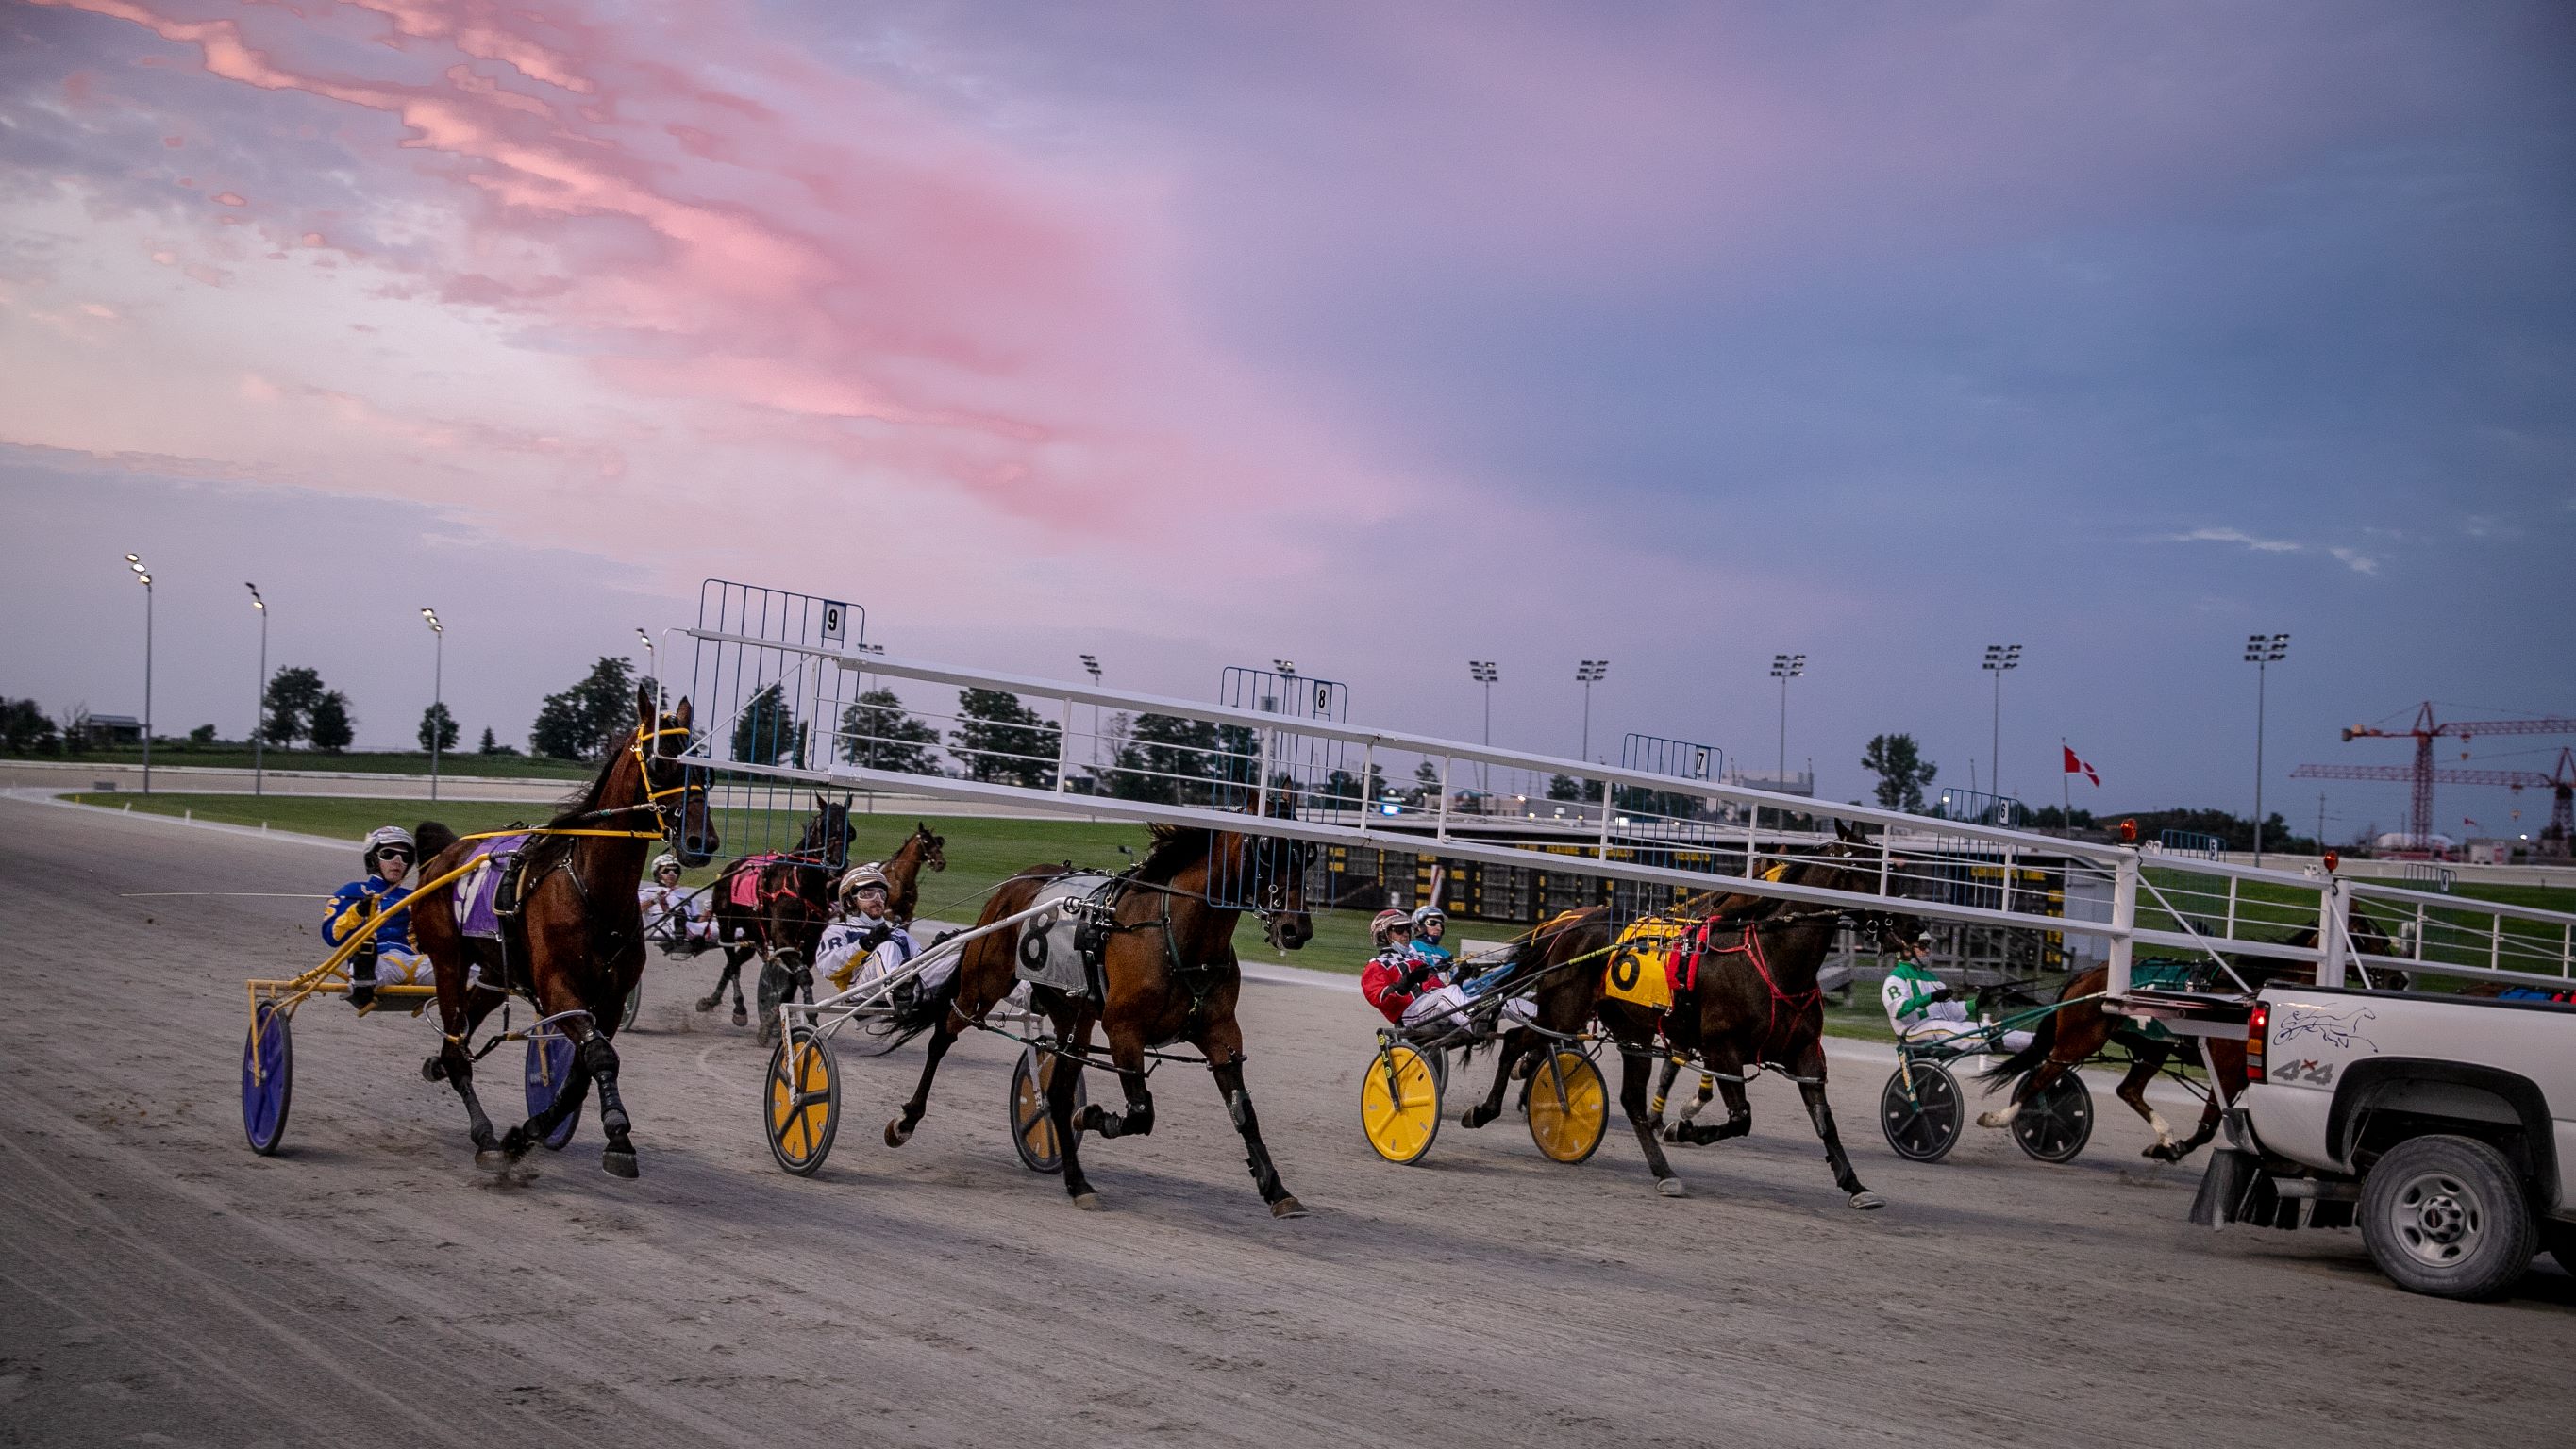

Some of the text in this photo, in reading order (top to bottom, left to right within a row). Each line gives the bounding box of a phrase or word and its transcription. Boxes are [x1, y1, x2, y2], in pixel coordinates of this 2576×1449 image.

[828, 608, 838, 631] 9
[1318, 689, 1326, 708] 8
[1698, 752, 1705, 770] 7
[2000, 803, 2006, 819] 6
[1020, 905, 1059, 972] 8
[1887, 985, 1902, 1001] B
